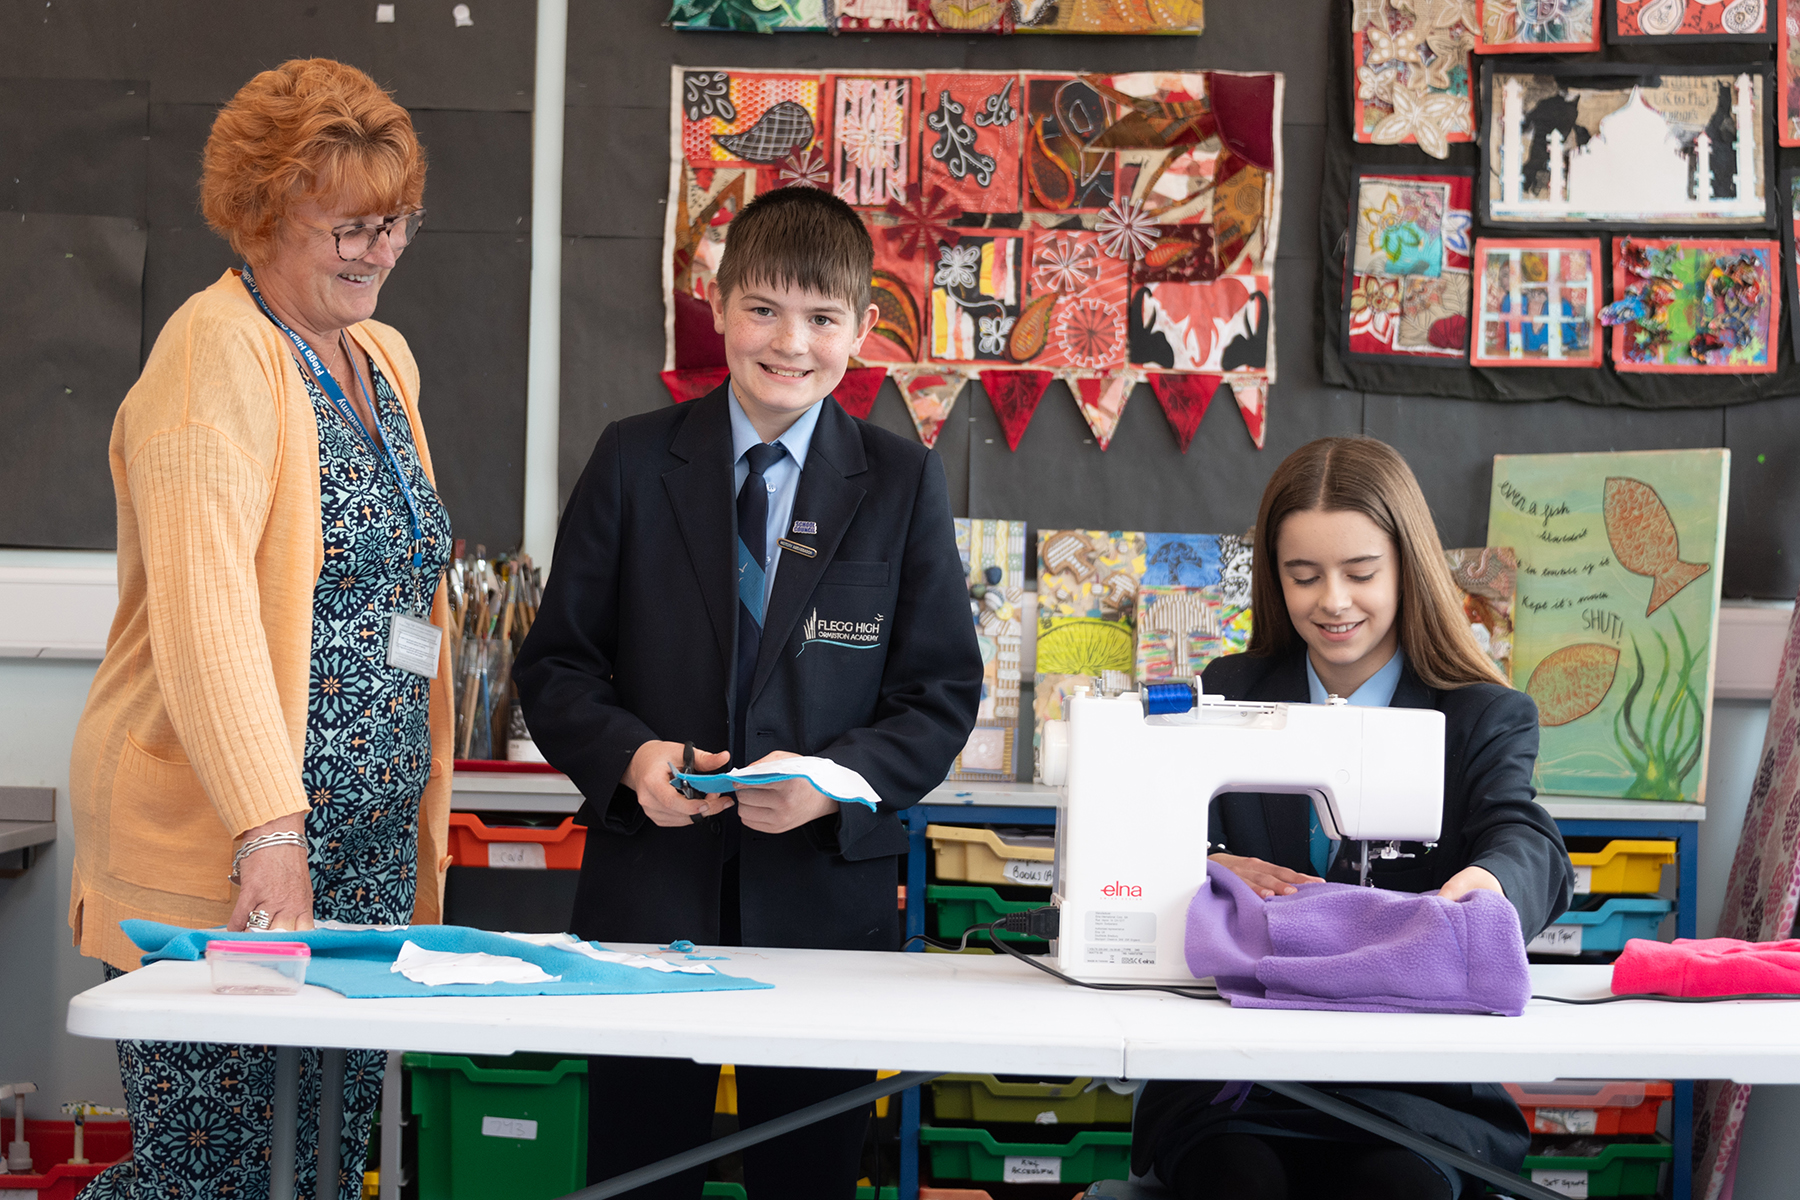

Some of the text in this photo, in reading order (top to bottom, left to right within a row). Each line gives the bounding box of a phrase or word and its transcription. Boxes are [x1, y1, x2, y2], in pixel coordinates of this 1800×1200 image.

[304, 349, 325, 377] Flegg
[336, 398, 367, 438] Academy
[1539, 501, 1570, 527] fish
[818, 620, 880, 634] FLEGG HIGH
[818, 631, 879, 641] ORMISTON ACADEMY
[1581, 607, 1624, 646] SHUT!
[1100, 880, 1142, 897] elna
